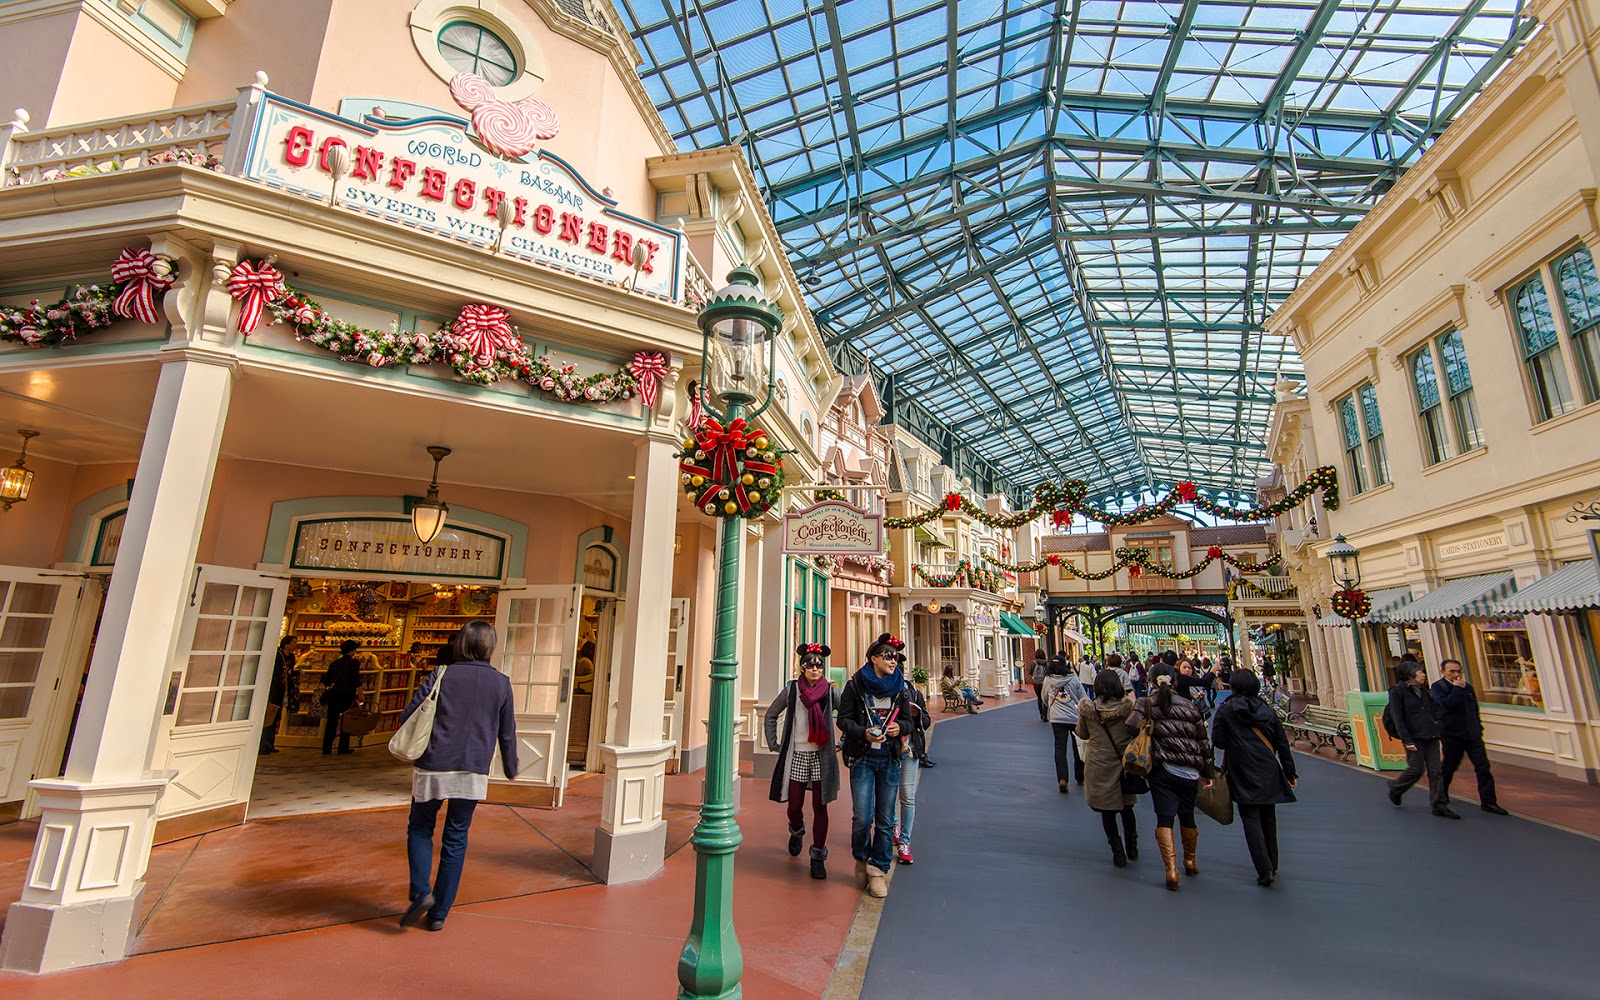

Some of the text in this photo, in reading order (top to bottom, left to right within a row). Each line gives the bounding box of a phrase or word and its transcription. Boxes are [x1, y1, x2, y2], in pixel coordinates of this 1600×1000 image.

[283, 125, 660, 275] CONFECTIONERY
[407, 139, 584, 212] WORLD BAZAAR
[346, 186, 613, 275] SWEETS WITH CHARACTER
[320, 538, 483, 560] CONFECTIONERY
[798, 516, 869, 543] Confectionery
